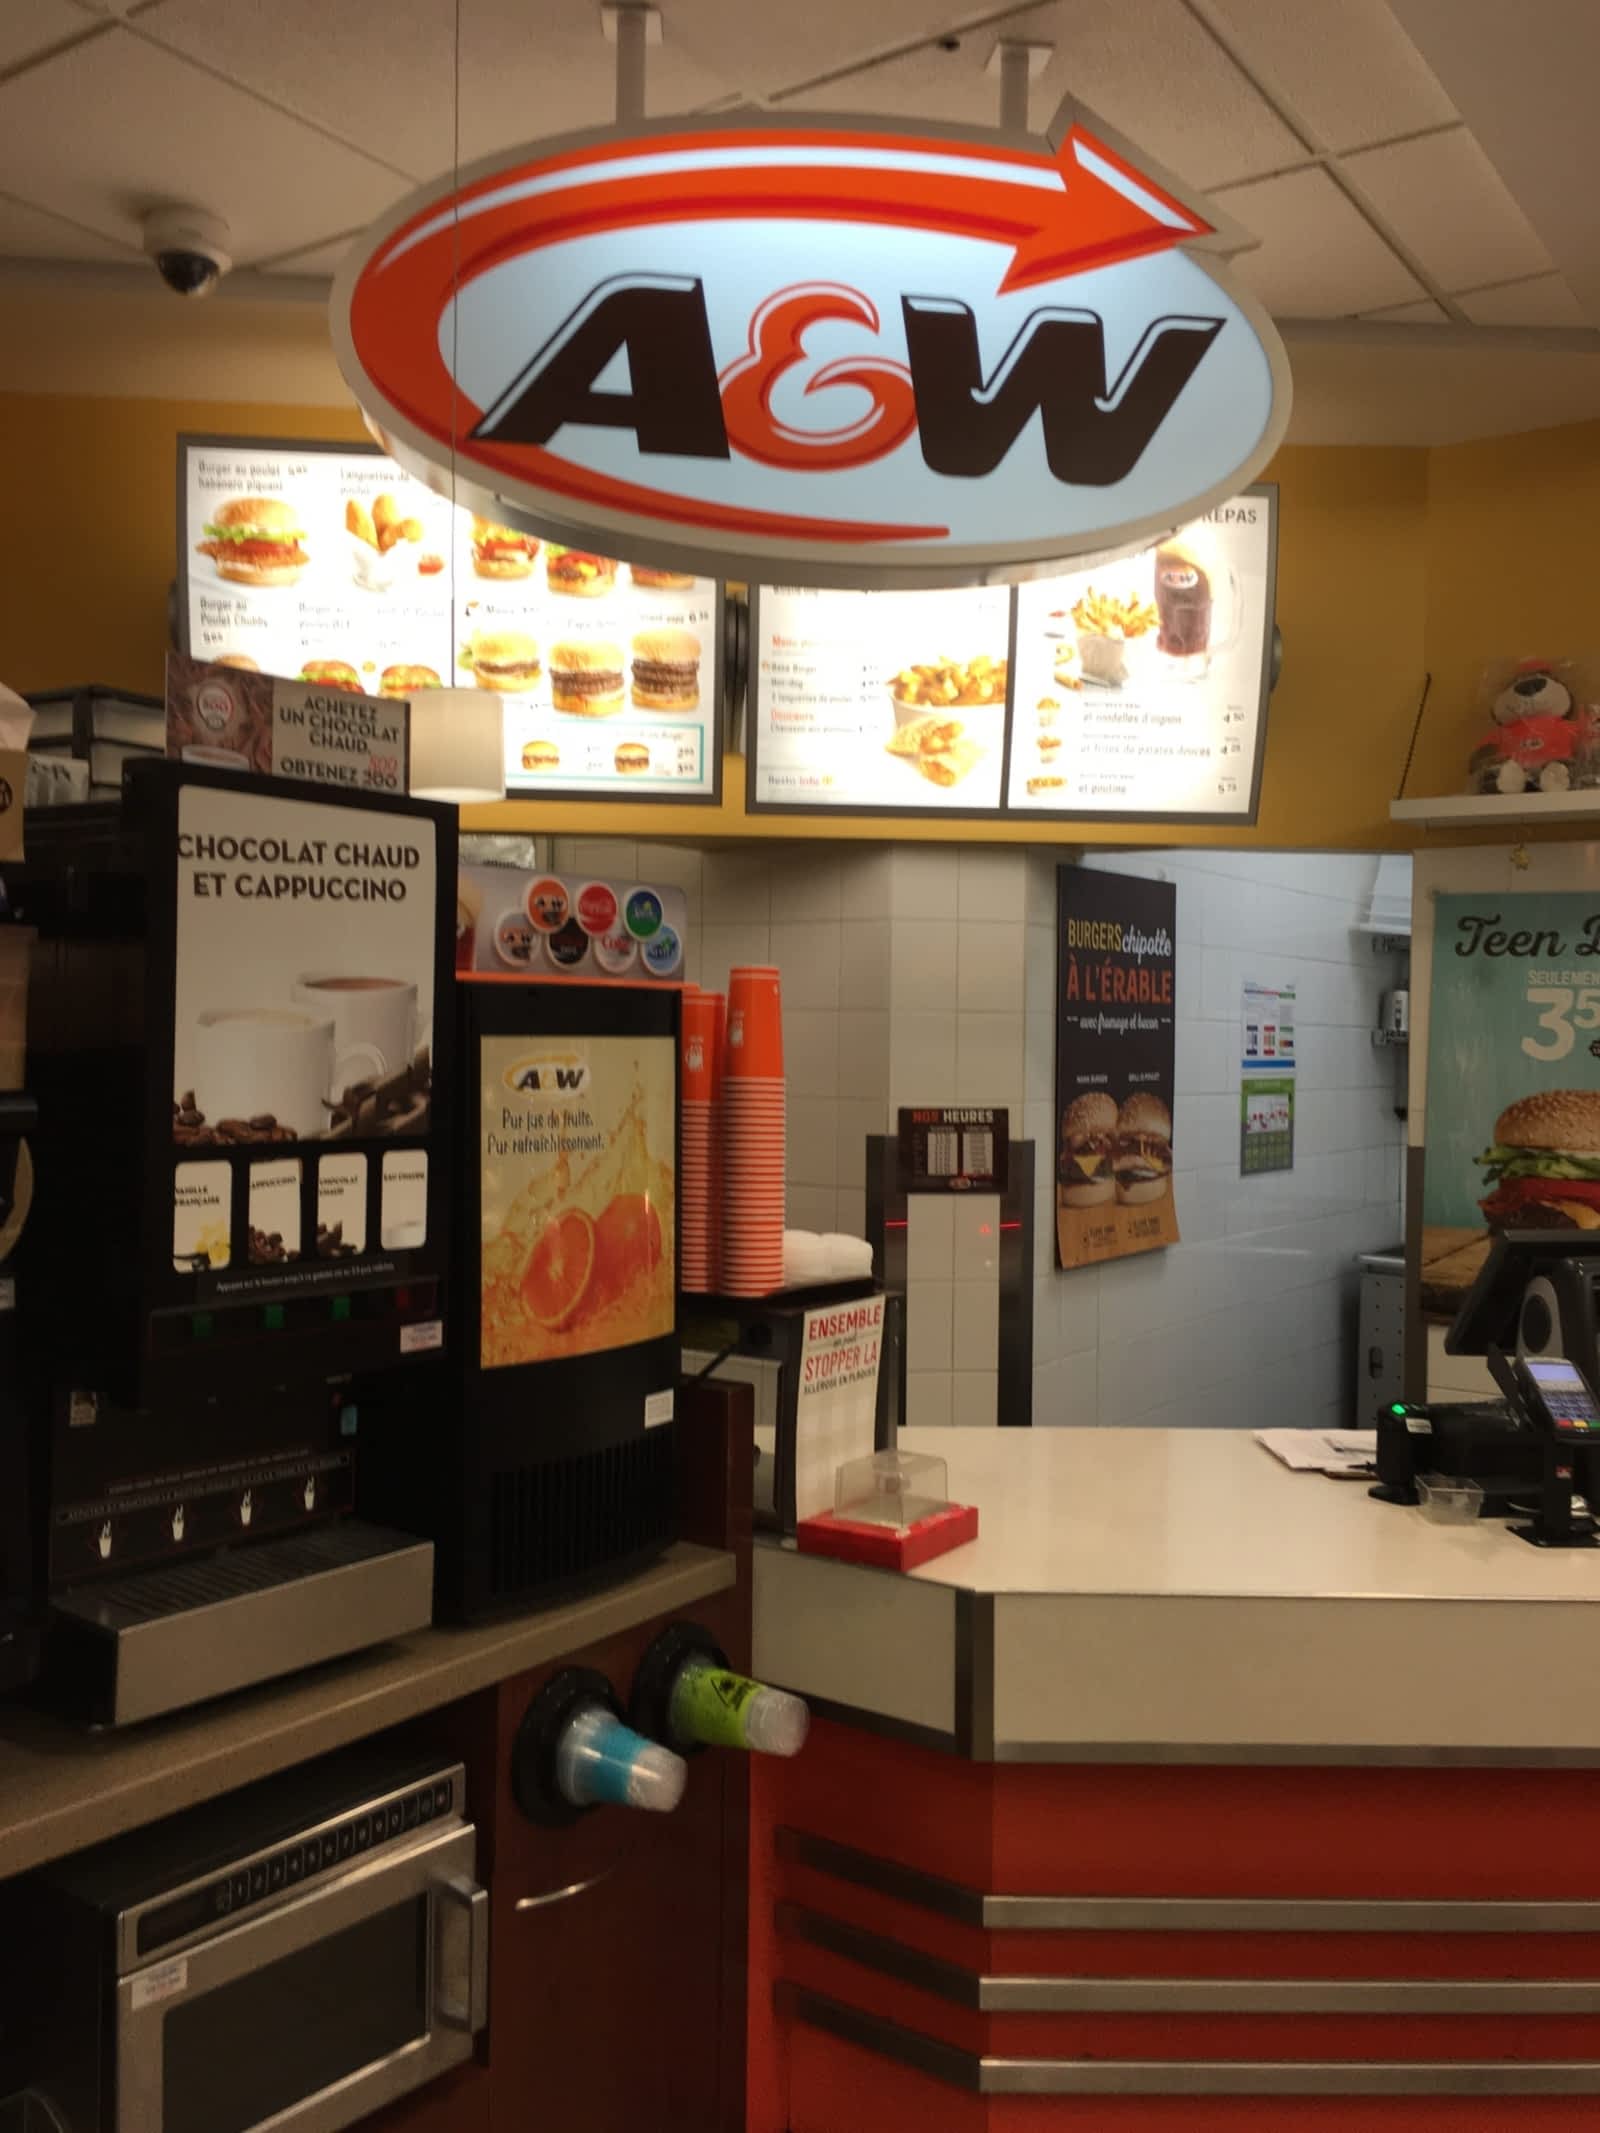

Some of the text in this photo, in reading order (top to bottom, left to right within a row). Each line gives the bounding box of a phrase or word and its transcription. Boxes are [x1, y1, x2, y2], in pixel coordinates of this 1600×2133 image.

[469, 272, 1227, 487] A&W
[279, 707, 400, 744] UN CHOCOLAT
[305, 696, 377, 721] ACHETEZ
[280, 756, 358, 783] OBTENEZ
[178, 834, 420, 870] CHOCOLAT CHAUD
[193, 872, 408, 903] ET CAPPUCCINO
[1067, 919, 1172, 965] BURGERS chipotle
[1454, 914, 1567, 958] Teen
[1067, 953, 1172, 1005] À L'ÉRABLE
[502, 1106, 523, 1129] Pur
[943, 1109, 994, 1123] HEURES
[487, 1131, 509, 1156] Pur
[808, 1303, 882, 1342] ENSEMBLE
[804, 1340, 877, 1382] STOPPER LA
